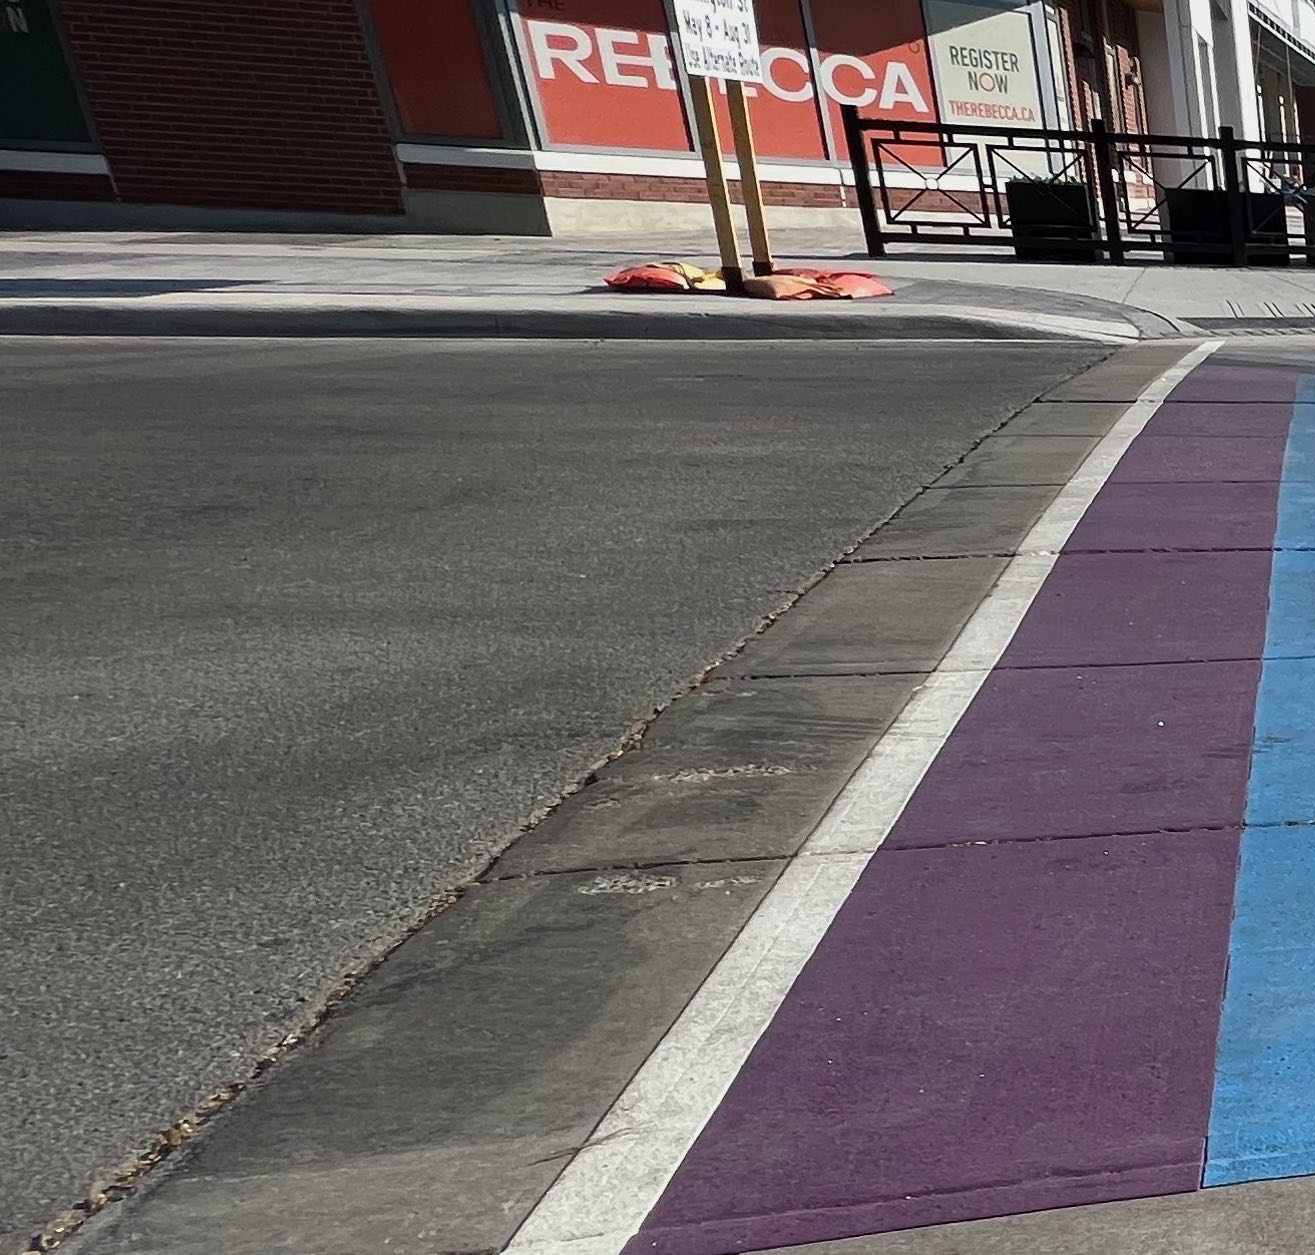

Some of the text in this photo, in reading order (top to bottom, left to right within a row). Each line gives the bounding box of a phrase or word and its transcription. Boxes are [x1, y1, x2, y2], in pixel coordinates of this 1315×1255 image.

[683, 10, 703, 41] May
[705, 14, 713, 39] 8
[723, 18, 741, 51] Aug
[528, 20, 930, 113] RECCA
[949, 45, 1020, 73] REGISTER
[967, 71, 1008, 94] NOW
[948, 99, 1036, 122] THEREBECCA.CA
